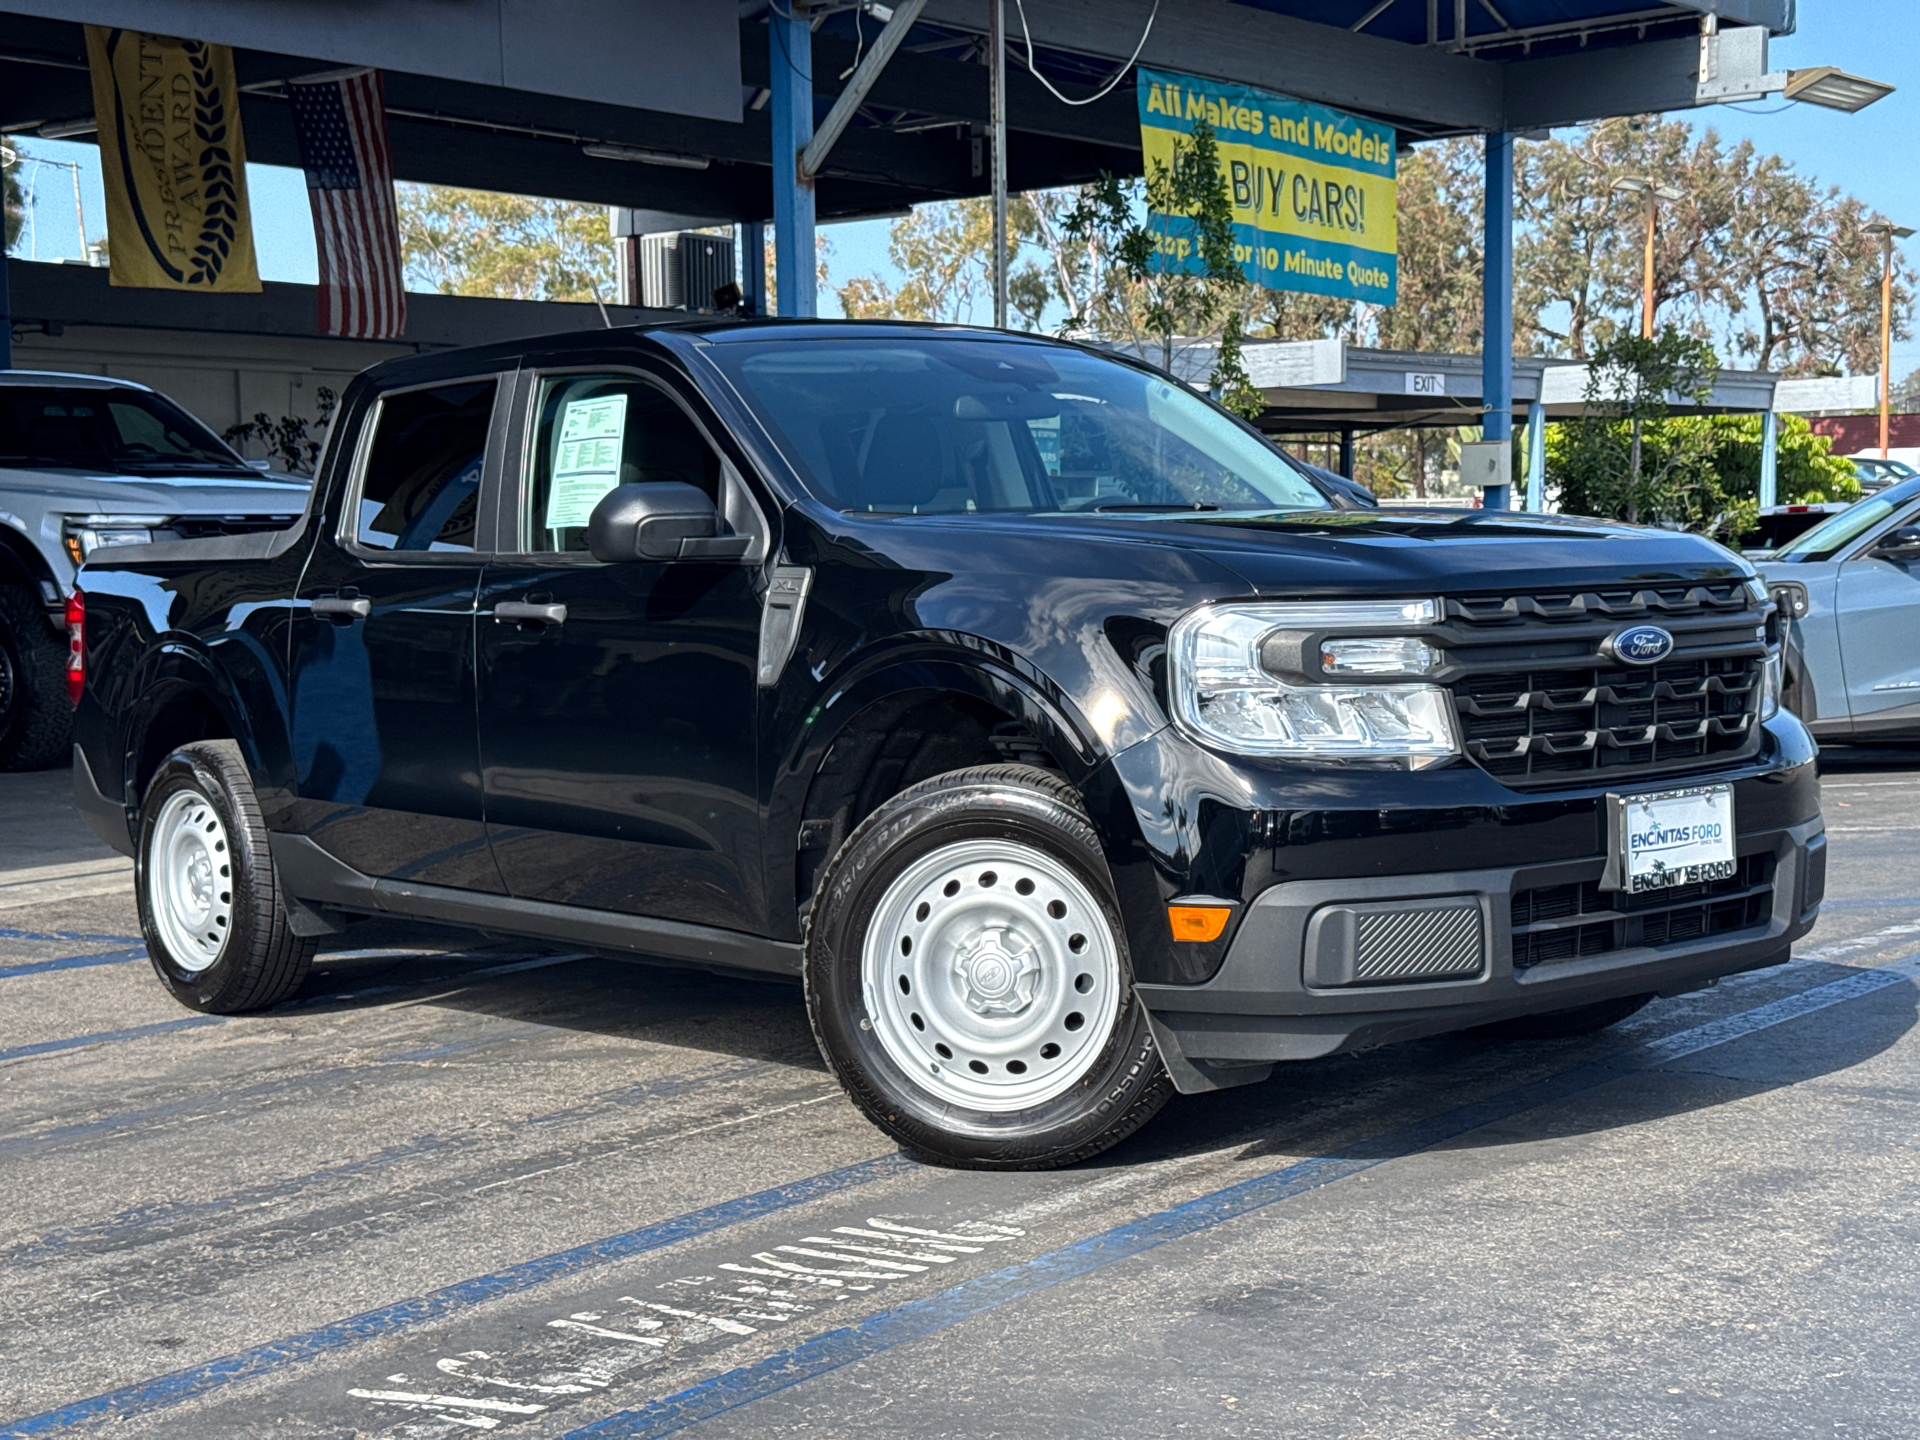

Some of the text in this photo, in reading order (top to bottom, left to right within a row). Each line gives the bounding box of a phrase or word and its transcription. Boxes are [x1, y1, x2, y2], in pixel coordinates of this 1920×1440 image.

[171, 73, 202, 214] AWARD
[1147, 83, 1389, 165] All Makes and Models
[1230, 160, 1366, 234] BUY CARS!
[1229, 241, 1253, 263] or
[1284, 250, 1343, 280] Minute
[1347, 261, 1389, 289] Quote
[1413, 375, 1436, 393] EXIT
[774, 580, 799, 592] XL
[1630, 633, 1667, 656] Ford
[1631, 823, 1722, 849] ENCINITAS FORD
[1632, 861, 1733, 892] ENCINITAS FORD
[1057, 1031, 1154, 1142] CROSSOVER
